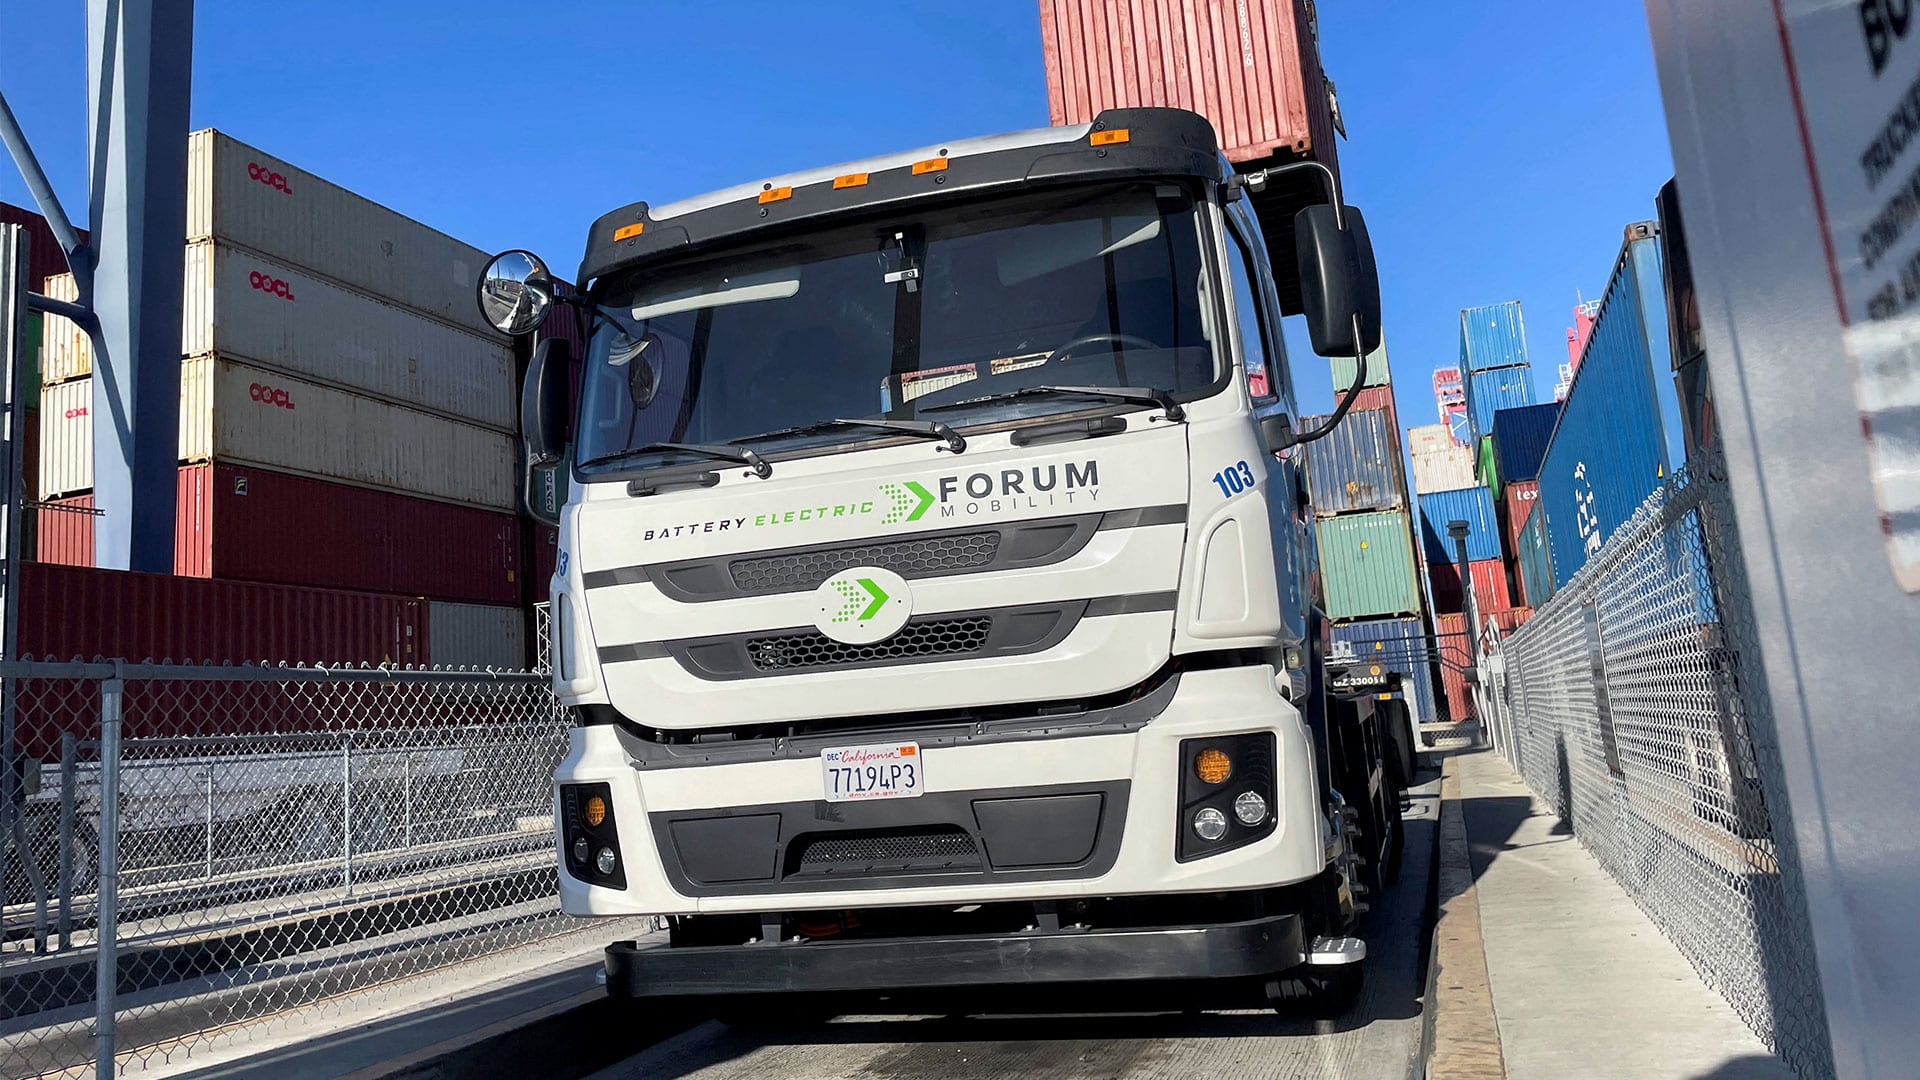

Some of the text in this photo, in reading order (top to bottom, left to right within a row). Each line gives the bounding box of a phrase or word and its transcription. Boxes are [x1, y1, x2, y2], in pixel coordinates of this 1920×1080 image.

[248, 162, 293, 195] OOCL
[249, 271, 295, 301] OOCL
[249, 383, 295, 410] OOCL
[939, 460, 1099, 503] FORUM
[1212, 460, 1255, 499] 103
[941, 489, 1099, 518] MOBILITY
[644, 501, 873, 541] BATTERY ELECTRIC
[827, 753, 839, 761] DEC
[841, 749, 901, 765] California
[829, 763, 915, 793] 77194P3
